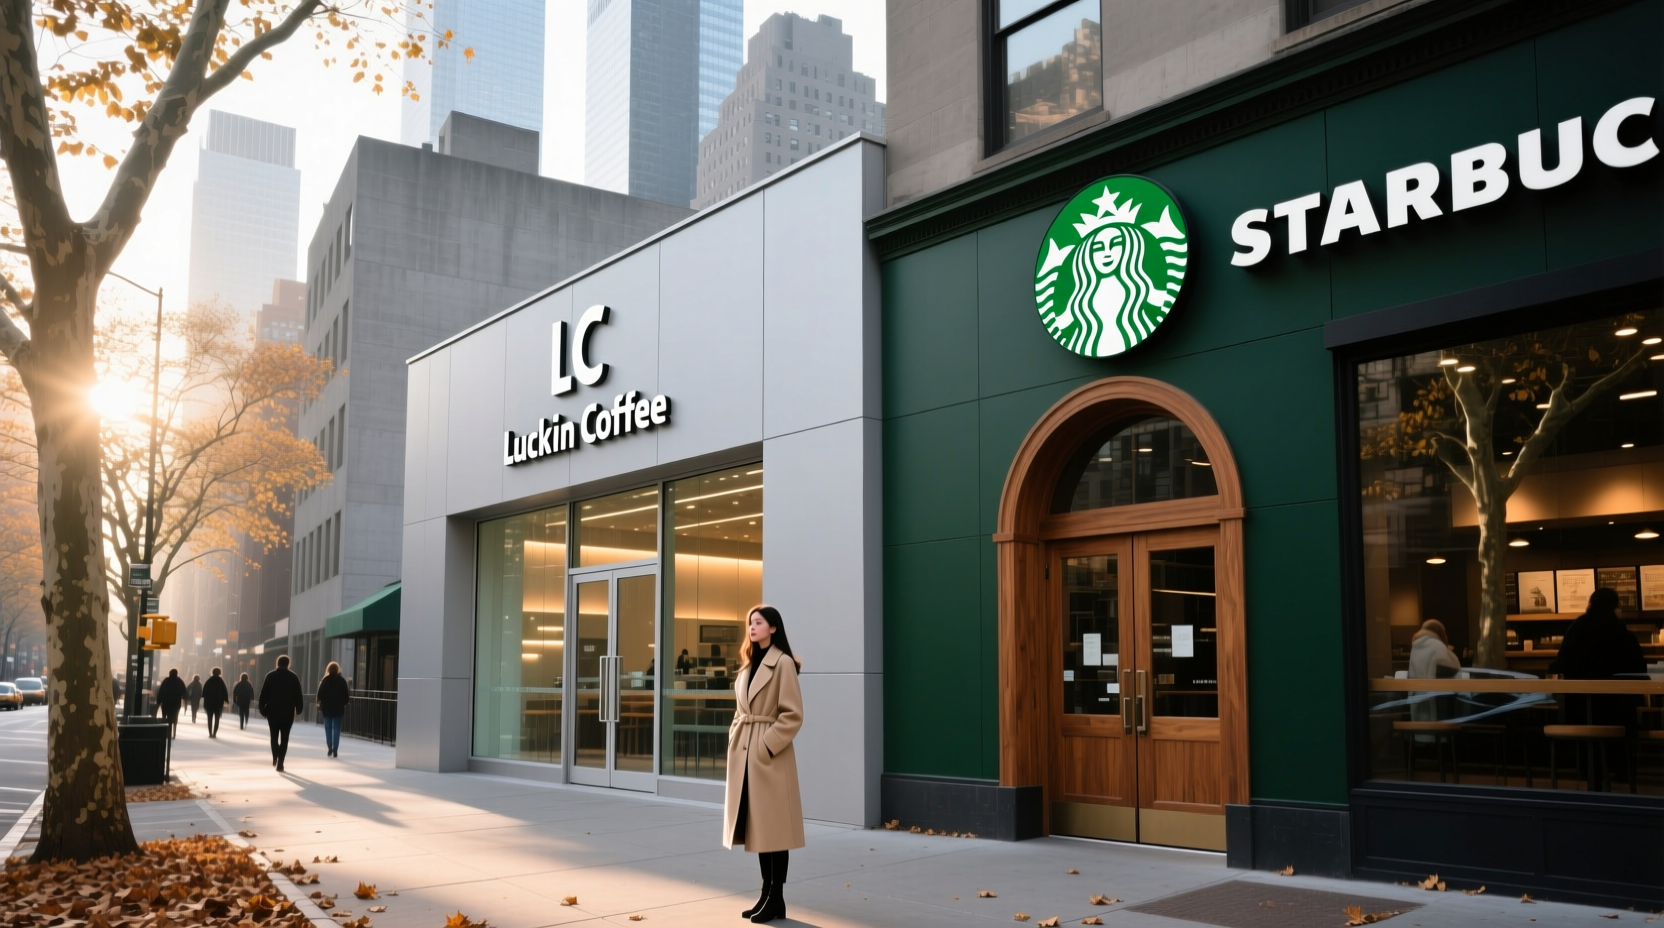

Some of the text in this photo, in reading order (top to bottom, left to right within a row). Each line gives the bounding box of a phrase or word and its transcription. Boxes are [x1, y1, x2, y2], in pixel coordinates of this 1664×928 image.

[1230, 96, 1660, 267] STARBUC
[551, 304, 608, 396] LC
[503, 390, 669, 466] Luckin Coffee
